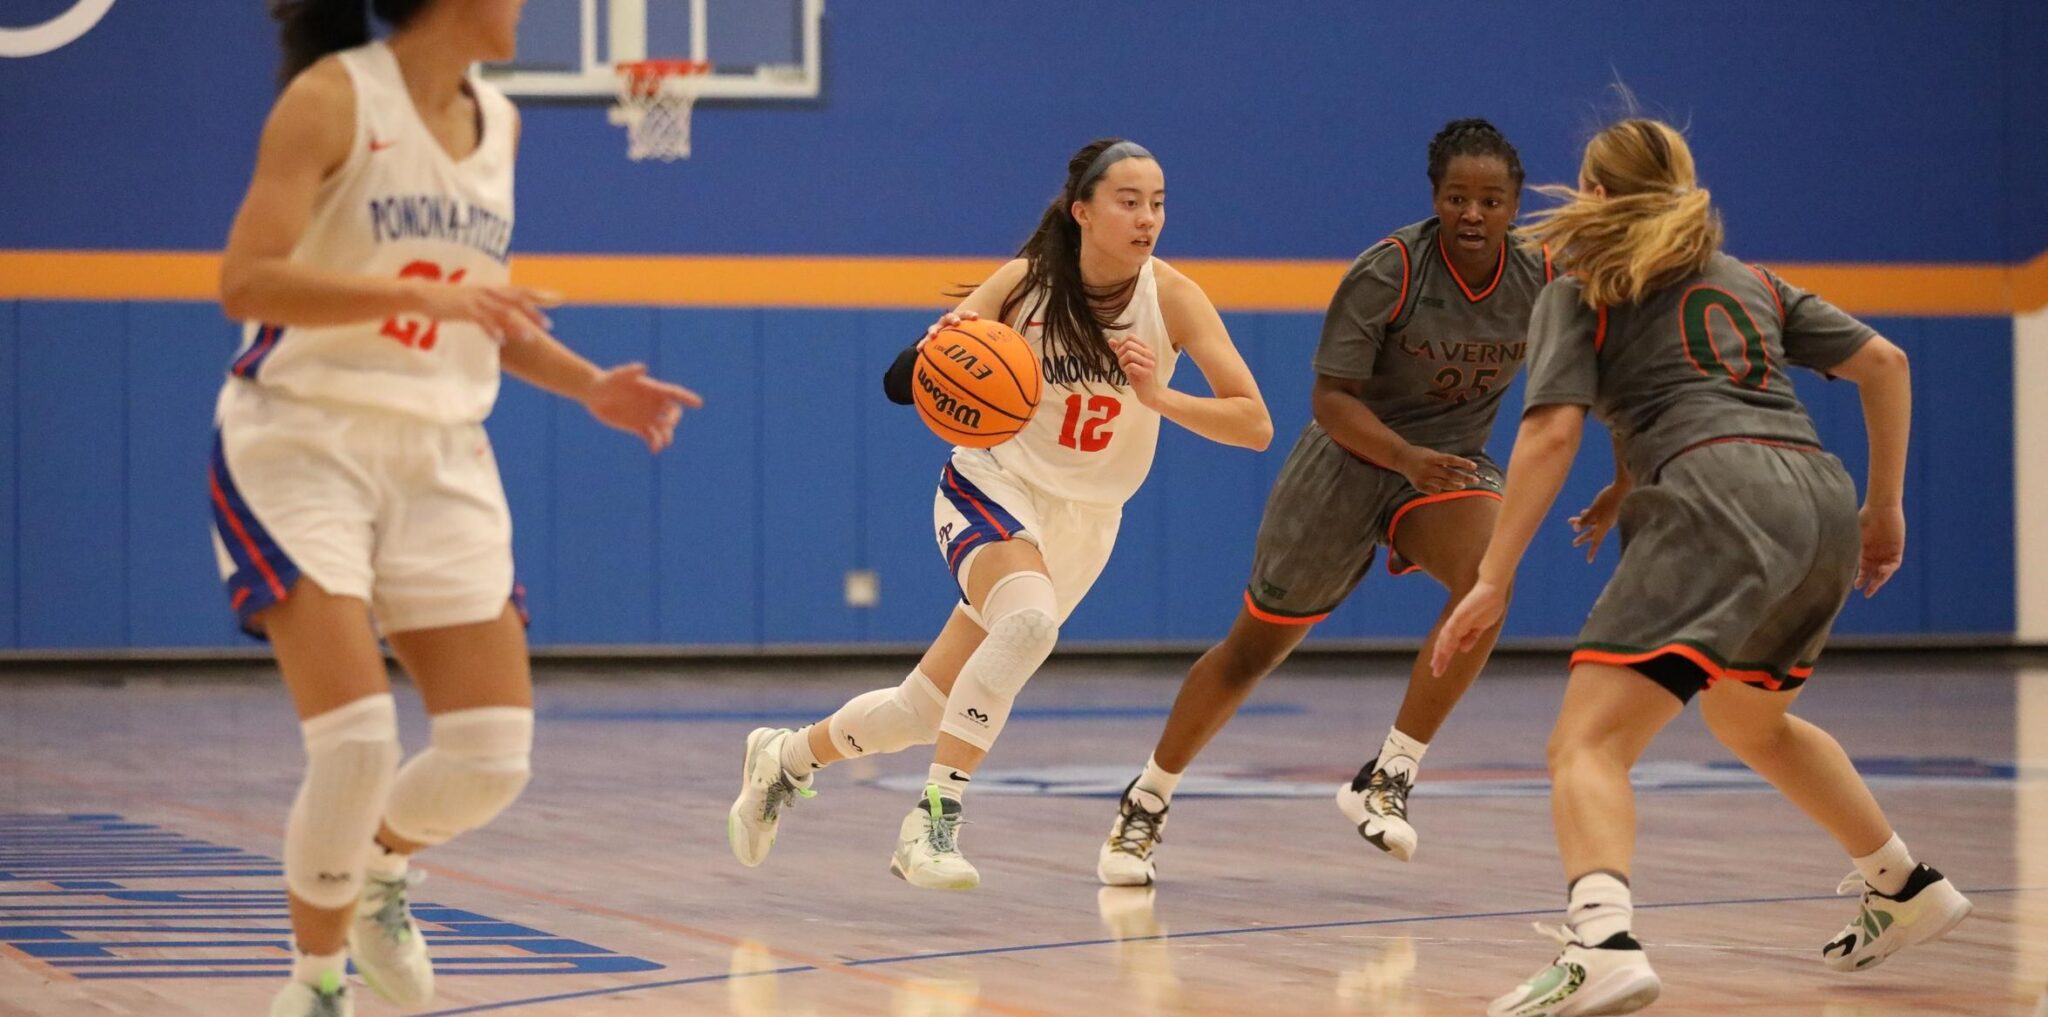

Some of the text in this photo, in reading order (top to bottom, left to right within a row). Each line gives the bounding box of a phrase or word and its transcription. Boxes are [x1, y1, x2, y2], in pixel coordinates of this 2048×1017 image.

[943, 344, 993, 380] EVO
[1679, 284, 1772, 391] 0
[918, 366, 981, 429] Wilson
[1424, 366, 1501, 404] 25
[1058, 393, 1122, 452] 12
